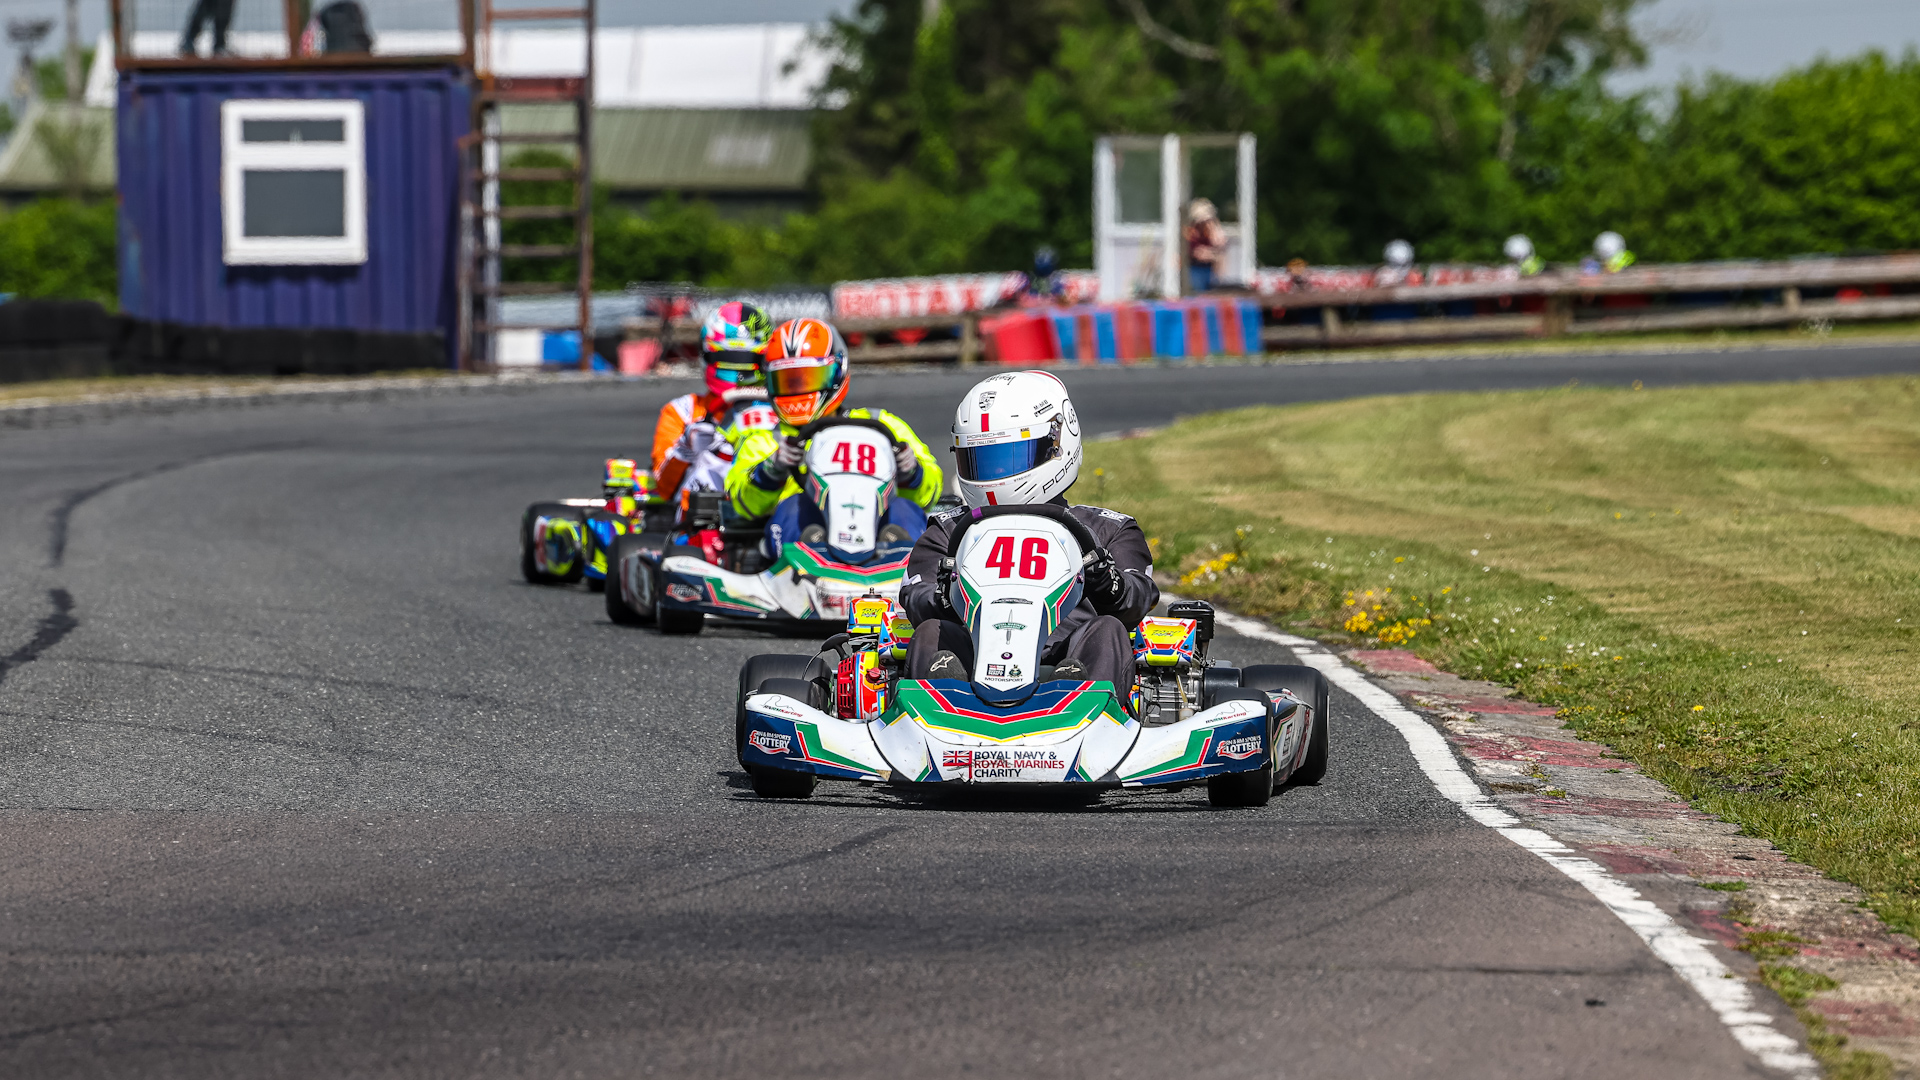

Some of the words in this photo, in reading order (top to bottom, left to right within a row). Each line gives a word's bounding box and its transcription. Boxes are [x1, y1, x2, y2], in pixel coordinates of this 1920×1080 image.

[831, 441, 876, 476] 48
[985, 536, 1049, 580] 46
[974, 751, 1012, 759] ROYAL
[1014, 751, 1046, 759] NAVY
[1048, 751, 1057, 760] &
[974, 760, 1012, 768] ROYAL
[1013, 760, 1065, 769] MARINES
[974, 769, 1022, 778] CHARITY
